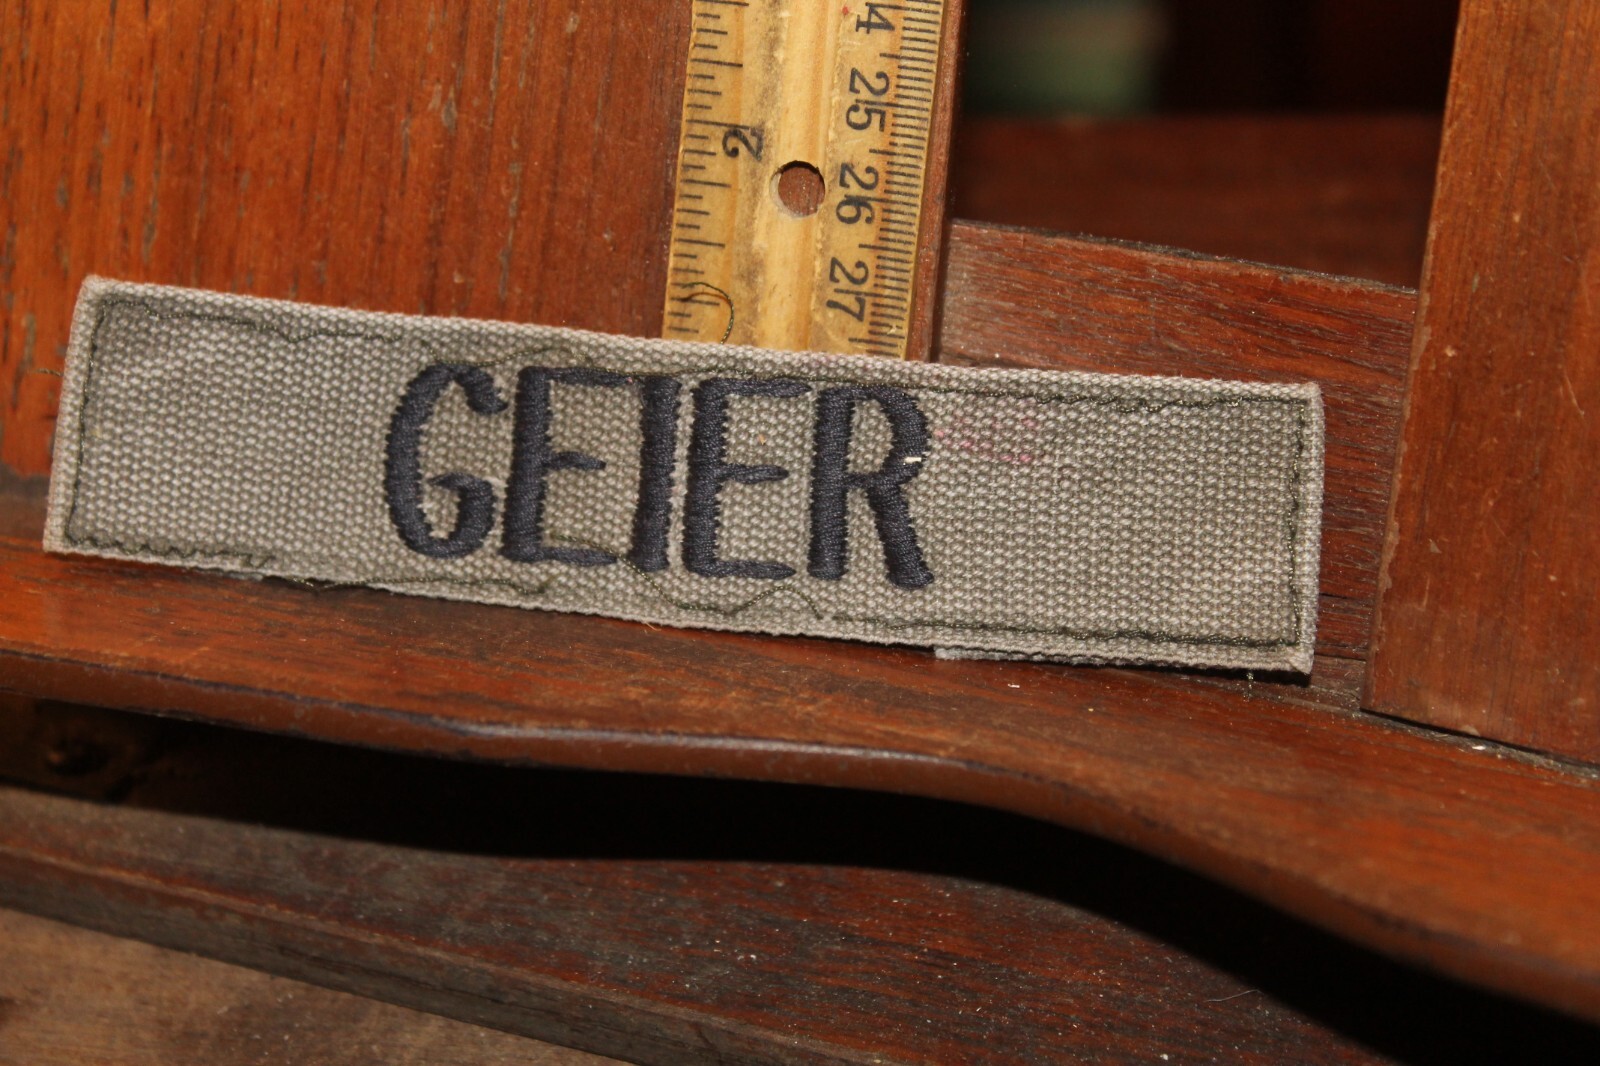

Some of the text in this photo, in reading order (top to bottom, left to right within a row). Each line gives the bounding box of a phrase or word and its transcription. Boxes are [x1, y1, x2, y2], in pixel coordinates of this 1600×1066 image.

[846, 67, 890, 132] 25
[722, 127, 764, 162] 2
[836, 162, 880, 225] 26
[826, 256, 870, 322] 27
[384, 363, 934, 589] GEIER
